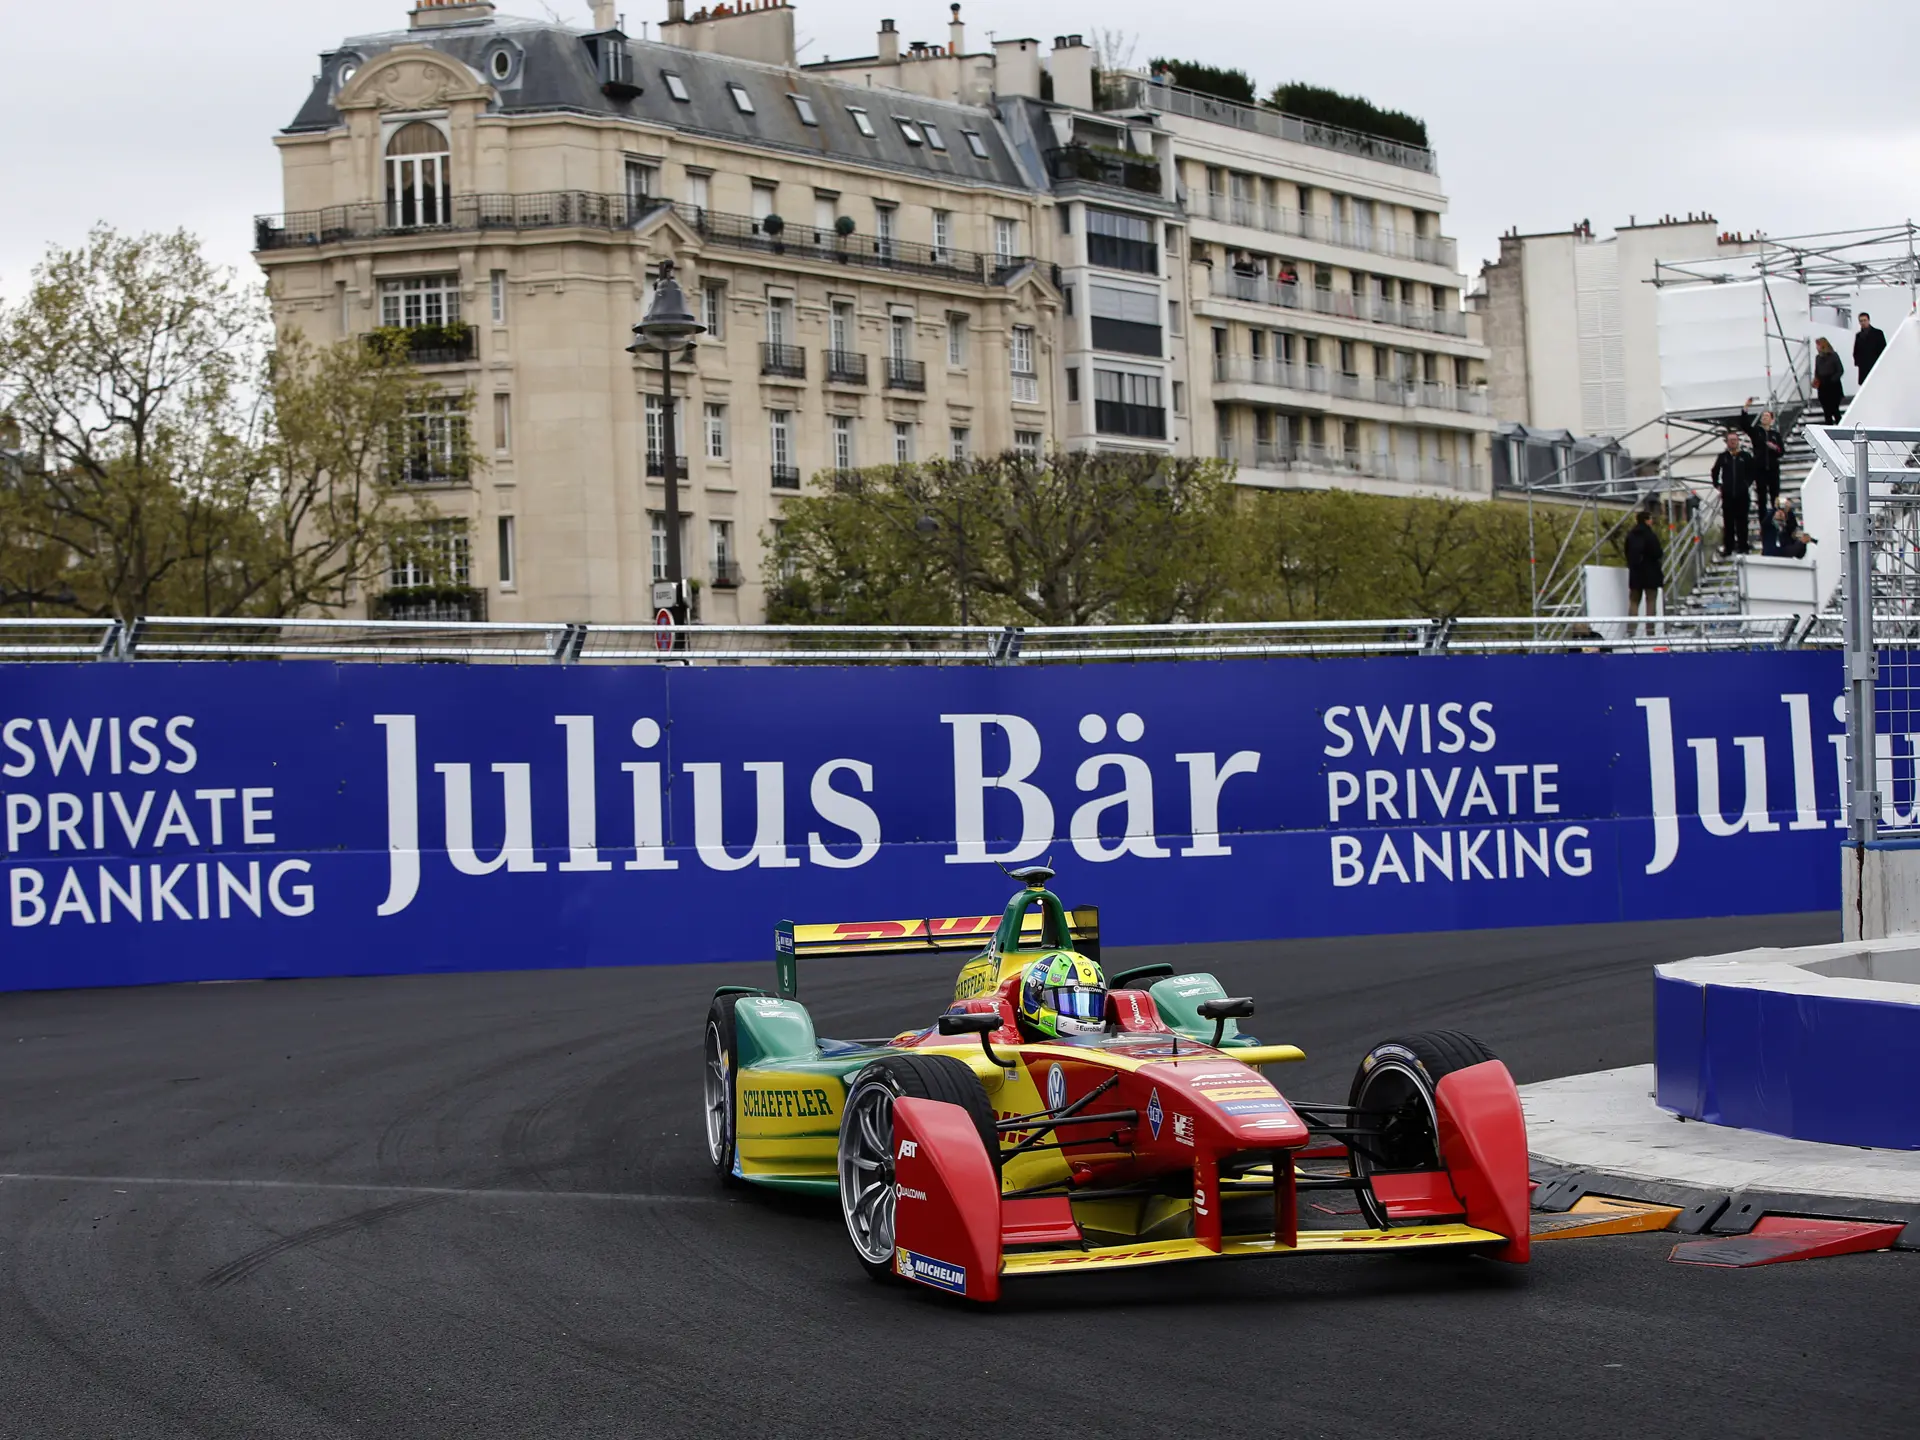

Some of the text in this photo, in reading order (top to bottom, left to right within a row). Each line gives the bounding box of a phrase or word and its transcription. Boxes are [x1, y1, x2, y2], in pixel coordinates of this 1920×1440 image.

[2, 716, 197, 778] SWISS
[1323, 701, 1496, 758] SWISS
[6, 787, 276, 852] PRIVATE
[373, 712, 1261, 917] Julius Bär
[1327, 763, 1560, 822] PRIVATE
[1330, 825, 1593, 887] BANKING
[9, 858, 315, 927] BANKING
[743, 1088, 834, 1117] SCHAEFFLER
[897, 1139, 918, 1160] ABT
[895, 1183, 927, 1201] QUALCOMM
[915, 1259, 964, 1285] MICHELIN
